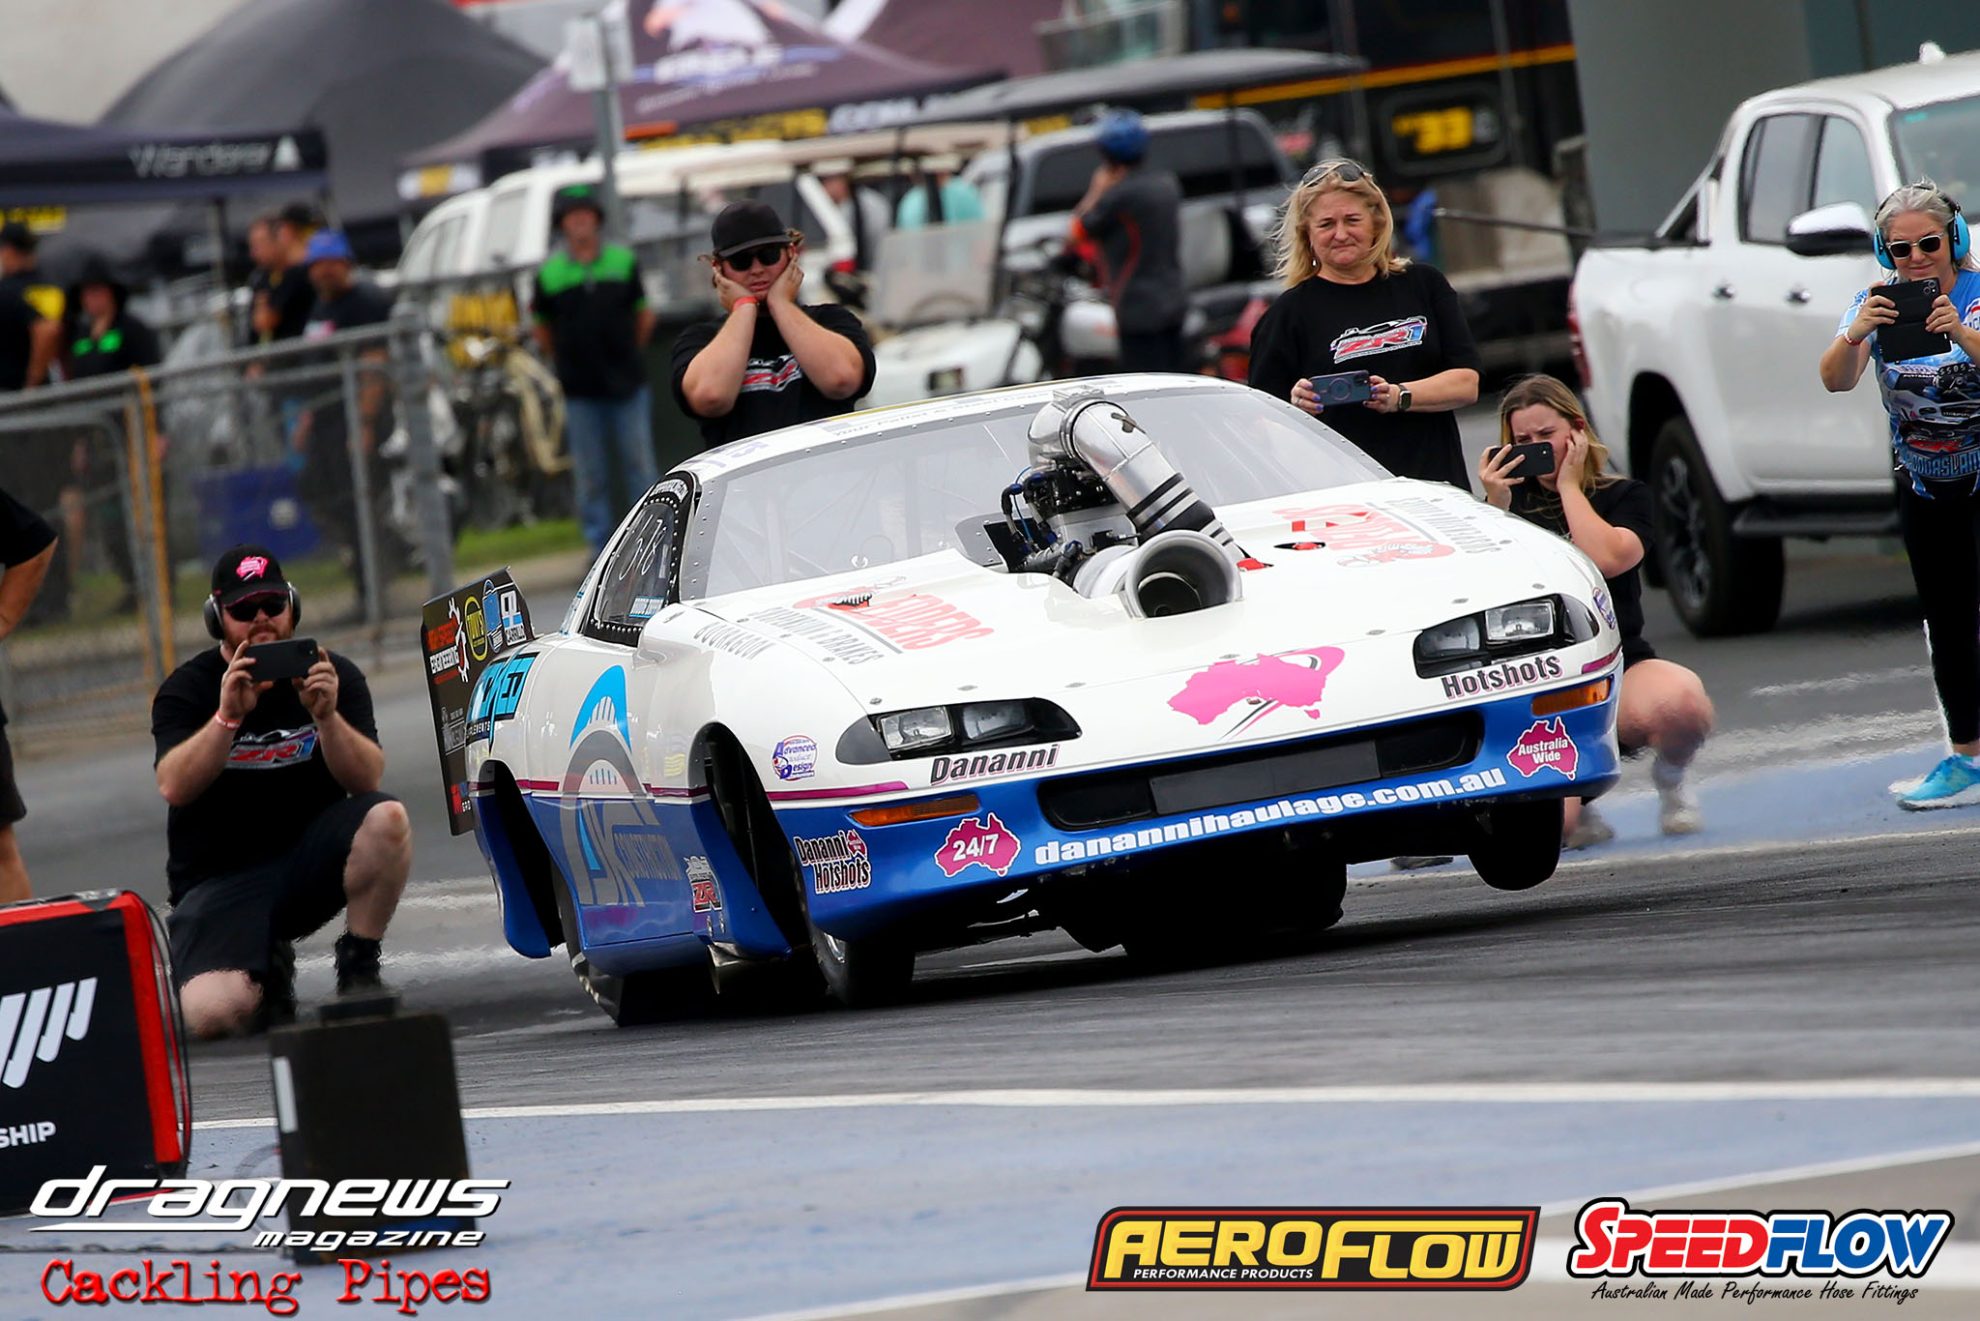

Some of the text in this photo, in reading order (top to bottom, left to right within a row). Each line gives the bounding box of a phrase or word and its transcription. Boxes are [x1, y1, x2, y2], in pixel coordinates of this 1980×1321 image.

[1441, 655, 1563, 699] Hotshots
[1518, 737, 1569, 756] Australia
[1532, 751, 1561, 764] Wide
[931, 744, 1061, 786] Dananni
[1035, 767, 1507, 866] danannihaulage.com.au
[794, 831, 851, 866] Dananni
[952, 833, 999, 862] 24/7
[815, 858, 871, 894] Hotshots
